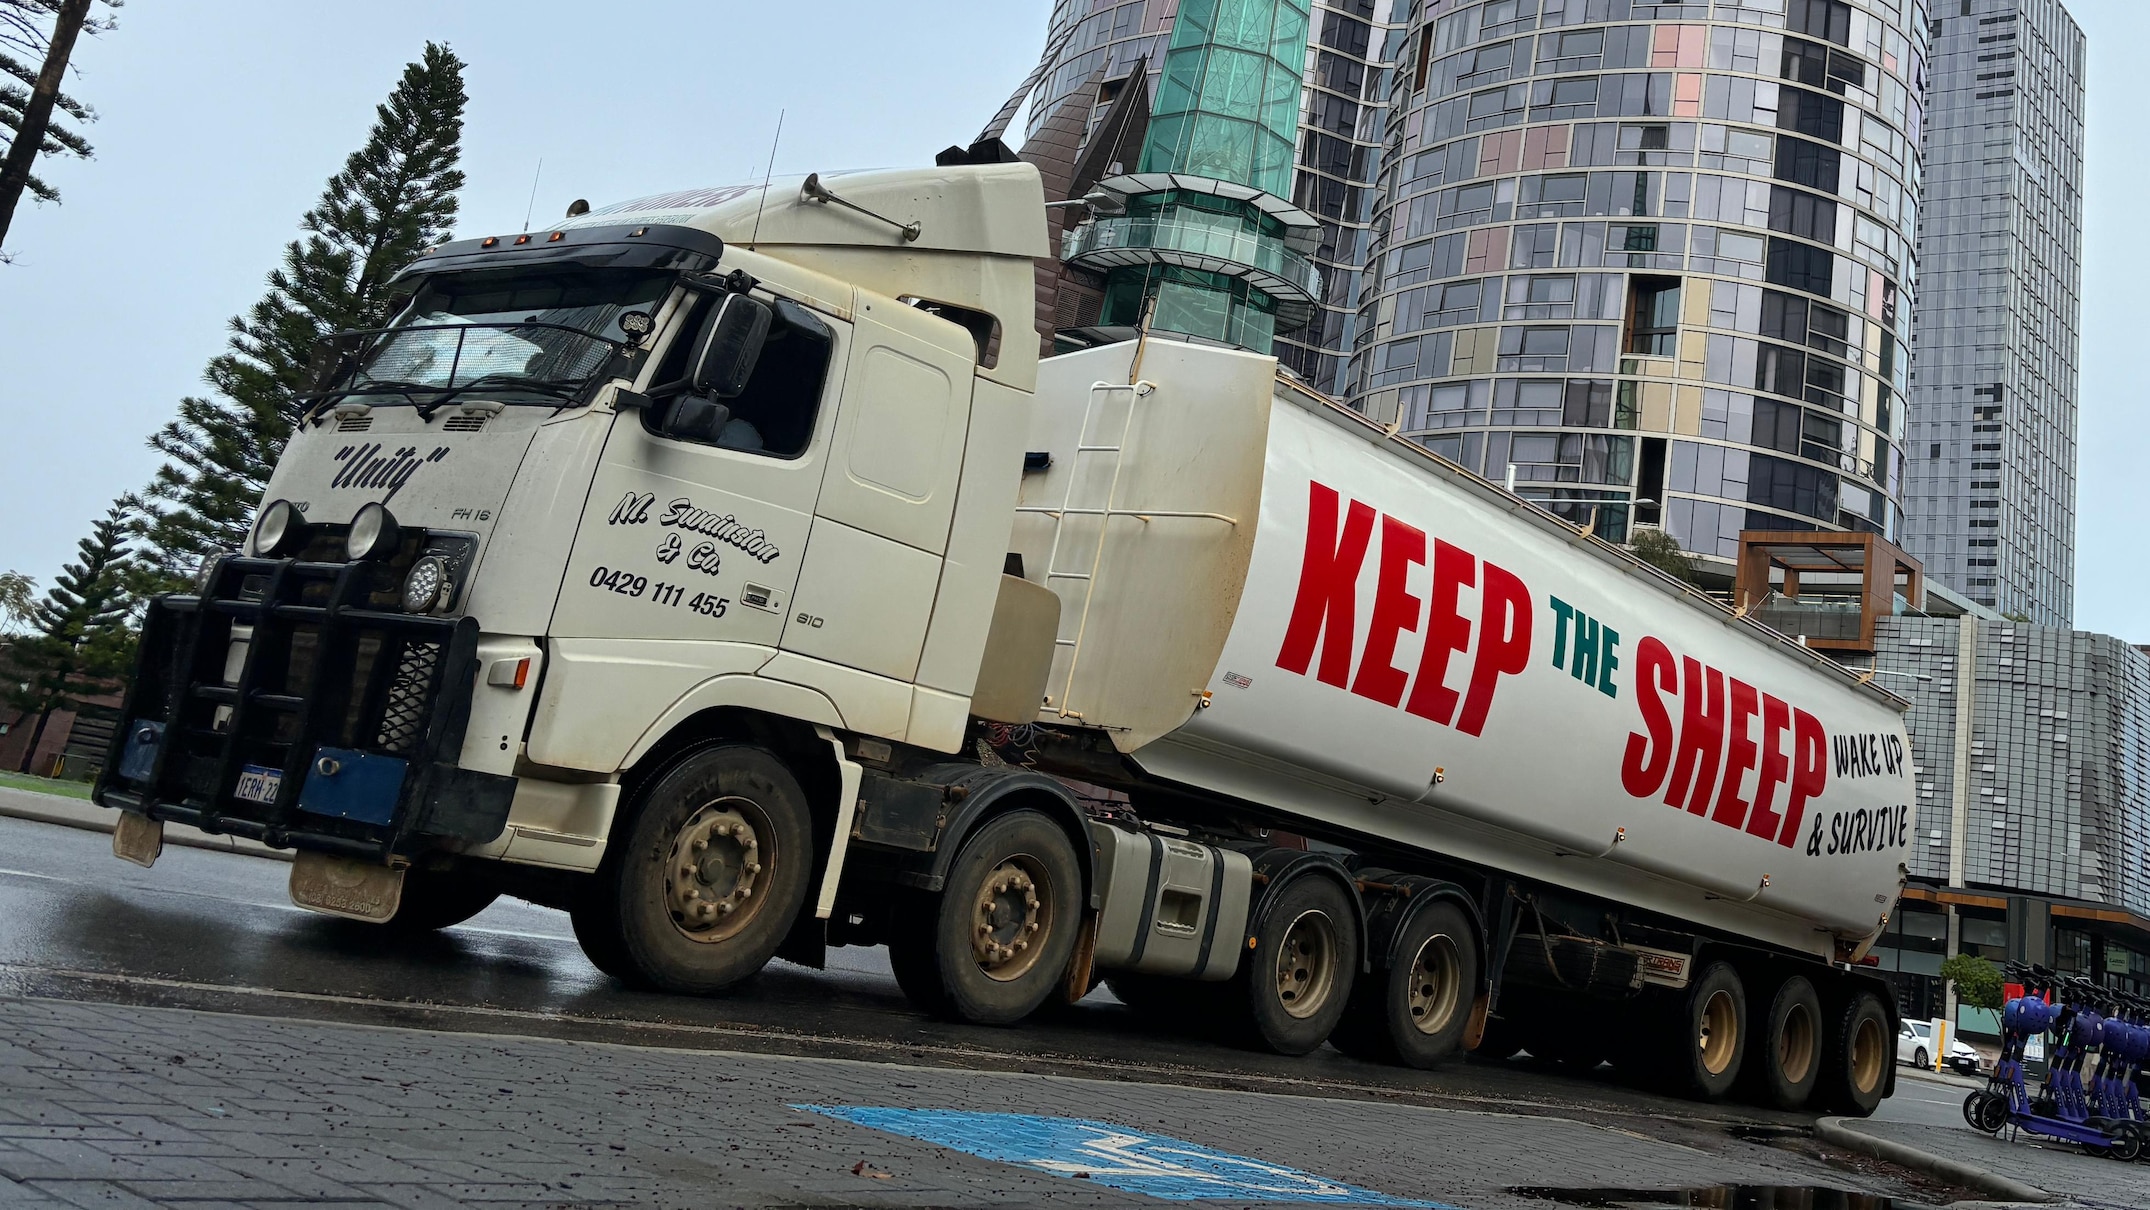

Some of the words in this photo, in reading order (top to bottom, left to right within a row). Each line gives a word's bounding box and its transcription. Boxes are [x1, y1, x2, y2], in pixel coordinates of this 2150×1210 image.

[451, 508, 473, 521] FH
[473, 509, 492, 522] 16
[608, 492, 656, 525] M.
[660, 497, 780, 564] Swainston
[656, 532, 682, 565] &
[686, 541, 721, 577] Co.
[589, 566, 648, 598] 0429
[652, 581, 686, 608] 111
[688, 592, 730, 619] 455
[796, 612, 824, 629] 610
[1276, 480, 1533, 738] KEEP
[1551, 596, 1620, 698] THE
[1622, 637, 1827, 848] SHEEP
[1833, 732, 1881, 780] WAKE
[1880, 733, 1903, 780] UP
[1806, 812, 1824, 857] &
[1826, 804, 1908, 856] SURVIVE
